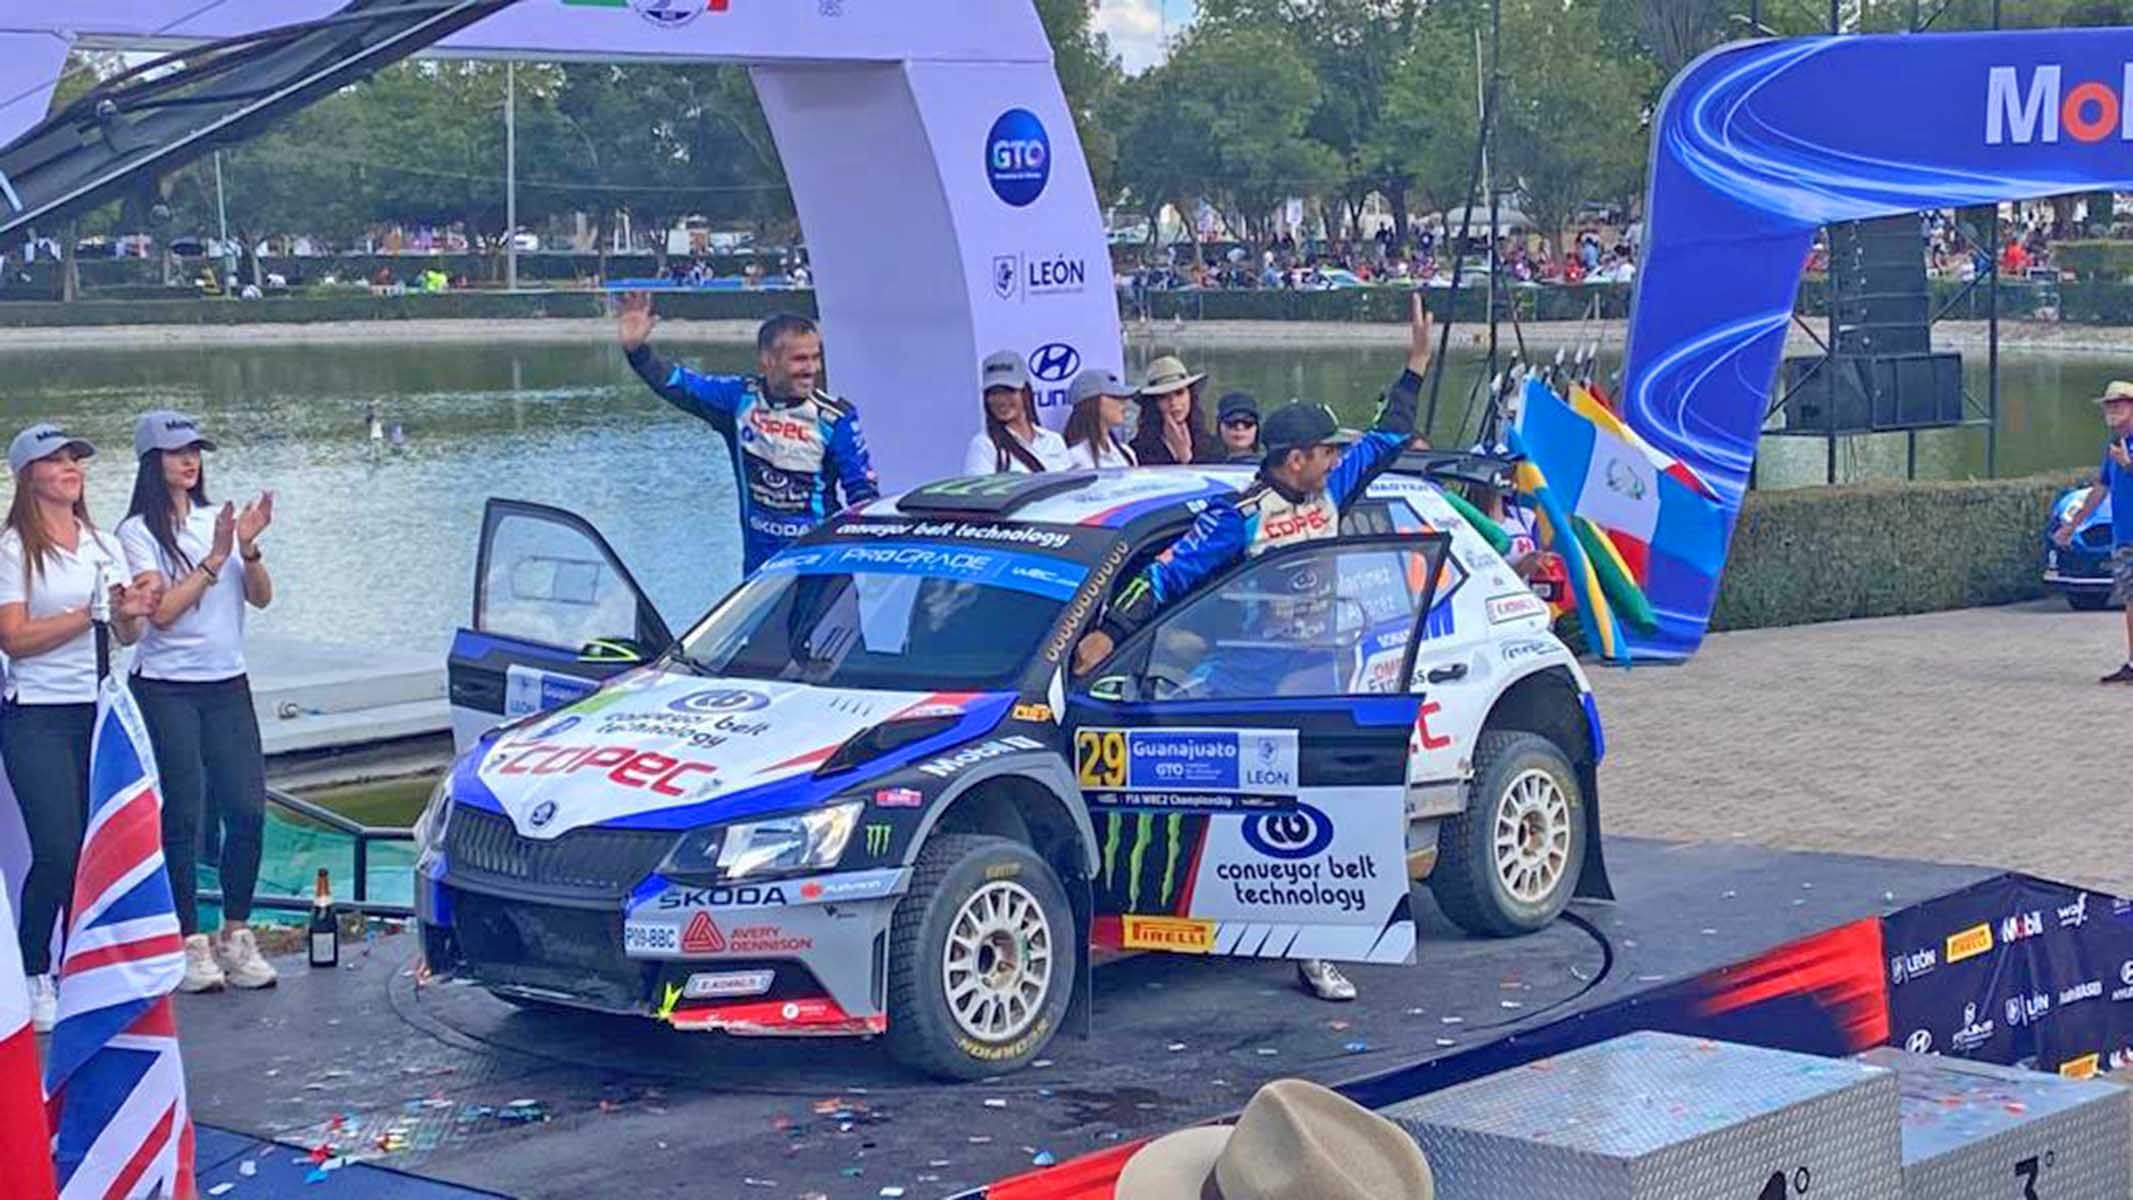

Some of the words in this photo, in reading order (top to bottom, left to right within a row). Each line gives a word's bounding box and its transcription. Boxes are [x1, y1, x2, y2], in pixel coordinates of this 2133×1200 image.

[992, 140, 1046, 169] GTO
[1029, 253, 1085, 286] LEÓN
[955, 523, 1071, 548] technology
[715, 715, 771, 736] belt
[1079, 731, 1127, 786] 29
[1133, 741, 1237, 760] Guanajuato
[1155, 763, 1184, 776] GTO
[1216, 861, 1321, 885] conveyor
[1329, 855, 1377, 879] belt
[1234, 881, 1366, 911] technology
[731, 927, 783, 938] AVERY
[731, 938, 813, 951] DENNISON
[1132, 921, 1207, 945] PIRELLI
